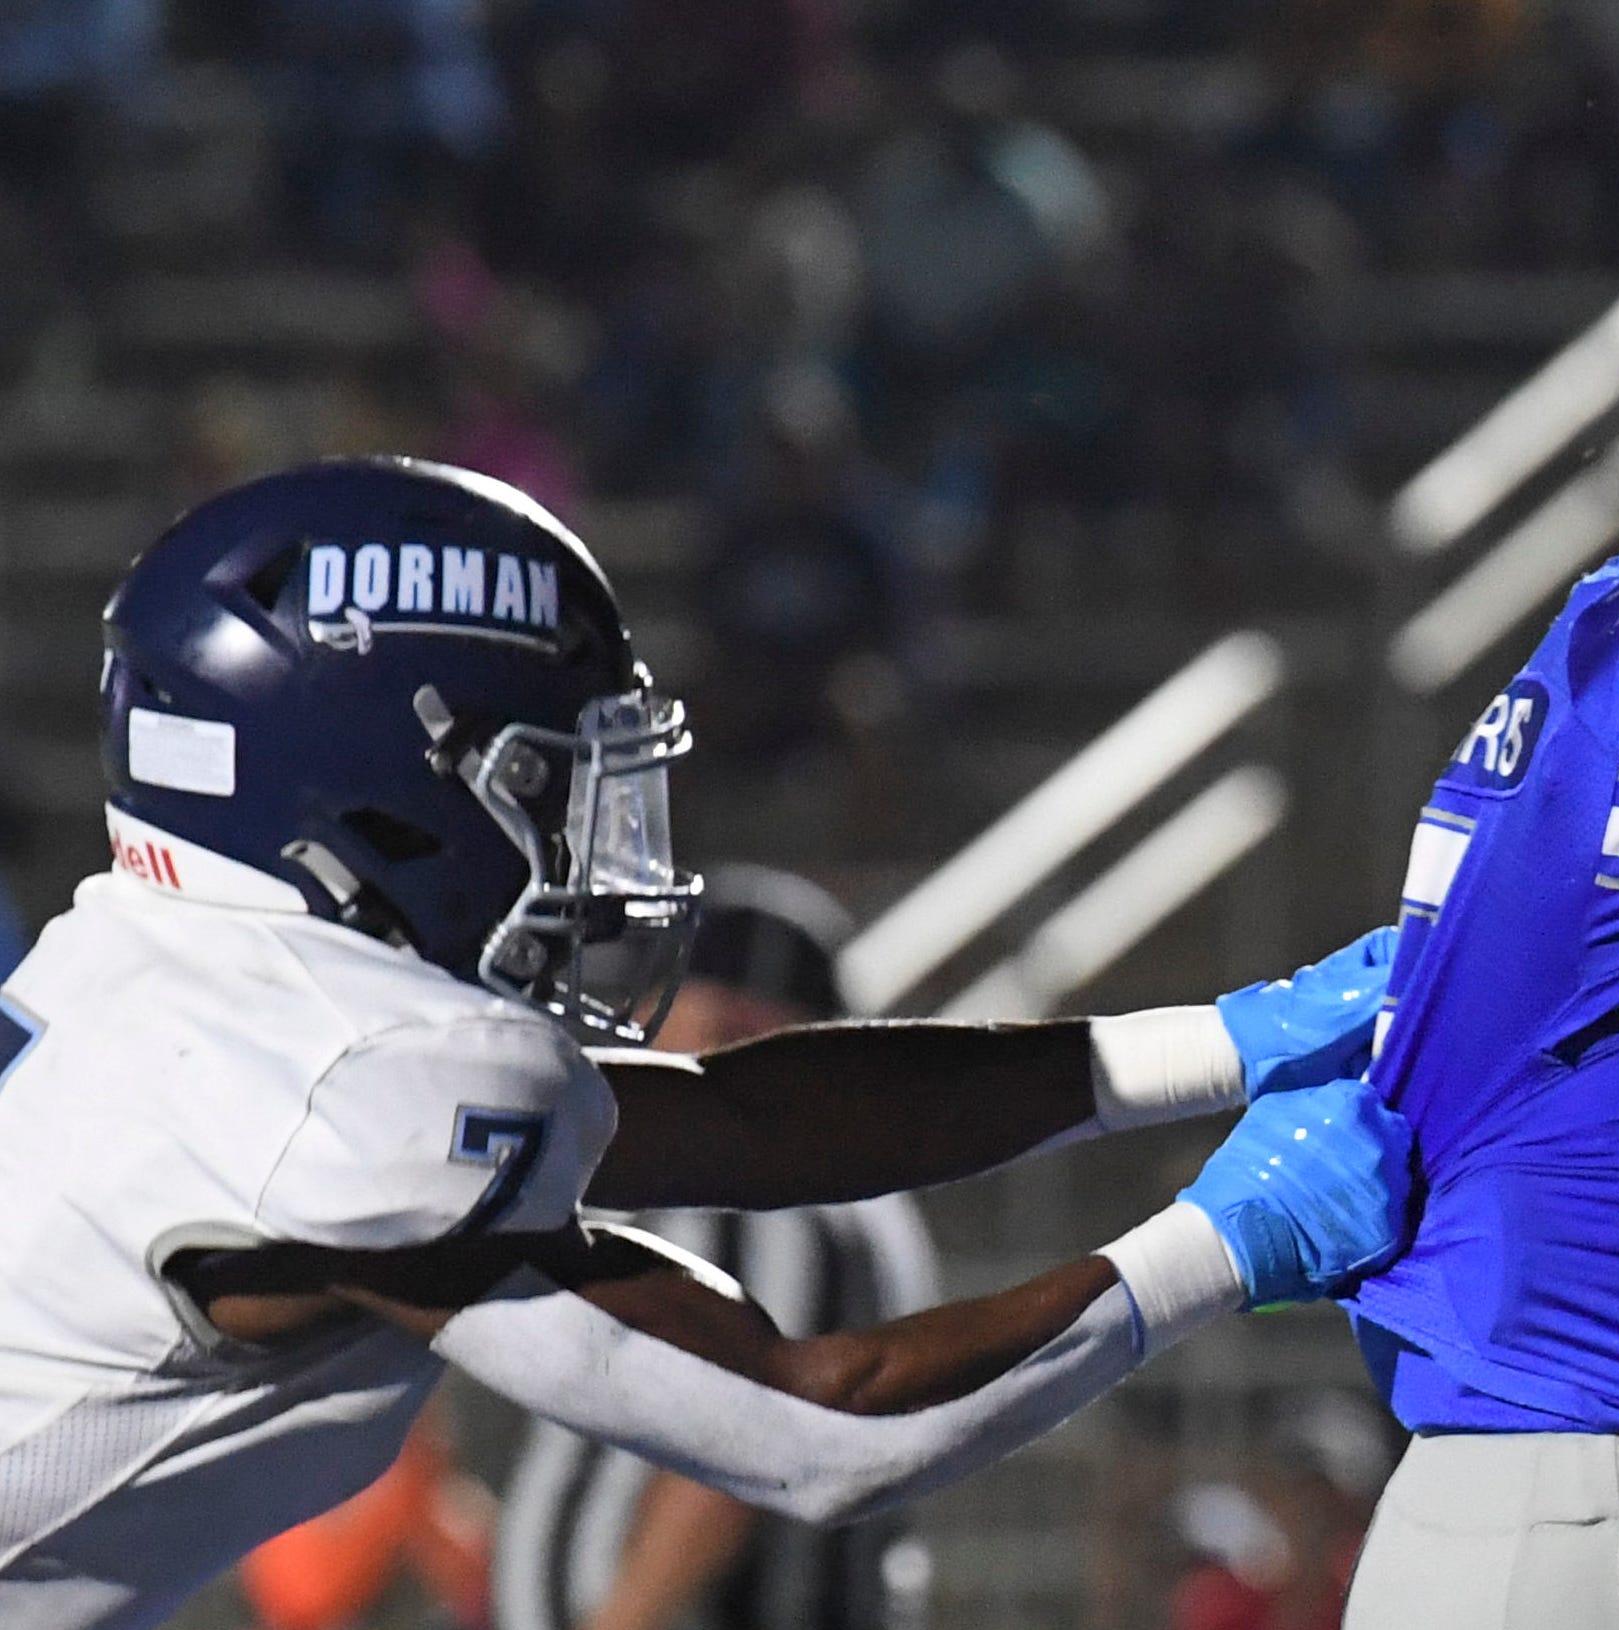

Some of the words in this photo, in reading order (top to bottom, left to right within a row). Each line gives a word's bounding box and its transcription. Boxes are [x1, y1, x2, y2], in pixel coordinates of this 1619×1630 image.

[308, 543, 558, 628] DORMAN
[1450, 693, 1533, 777] RS
[447, 1104, 554, 1236] 7
